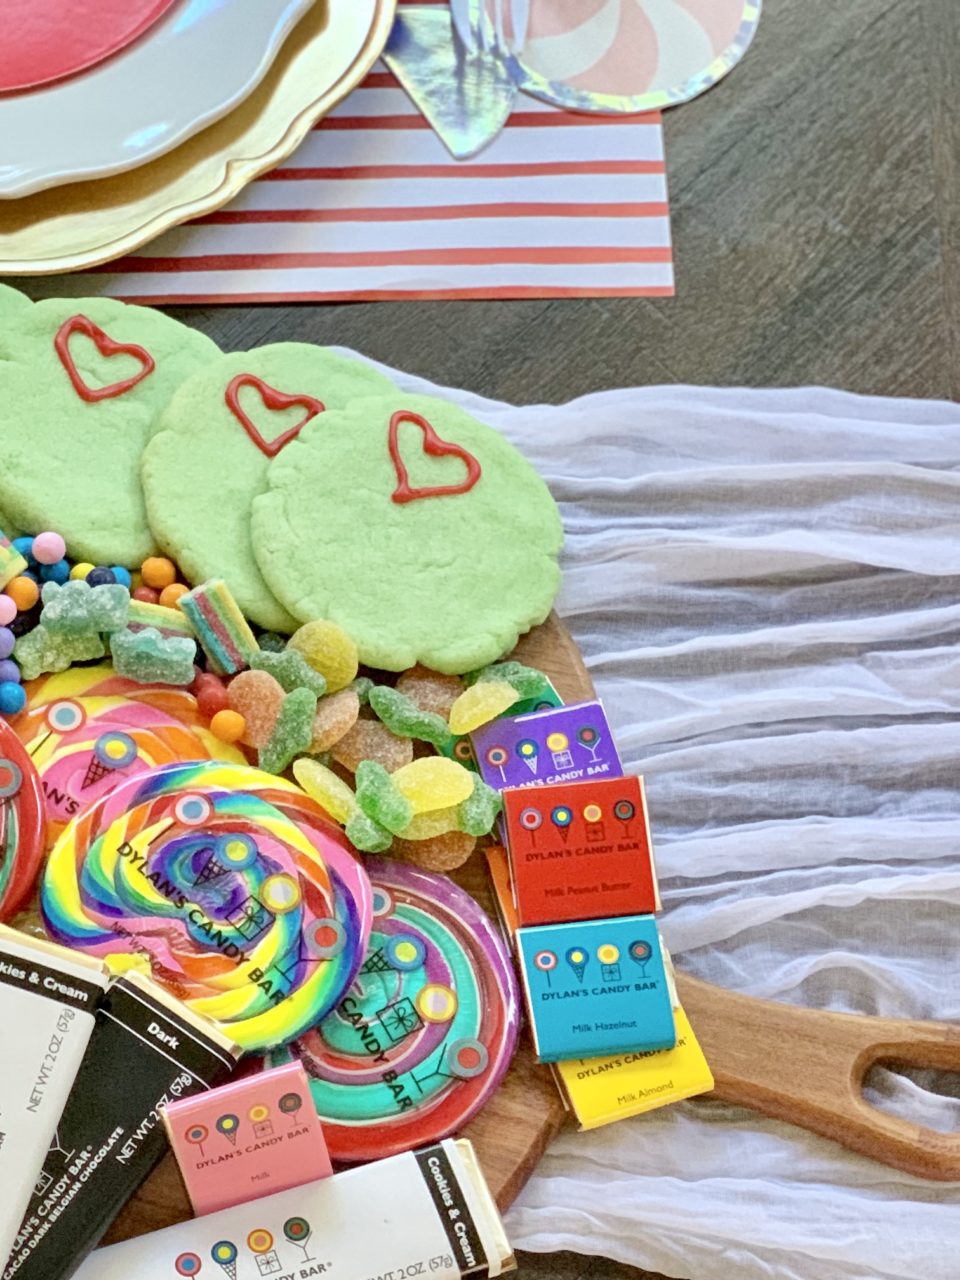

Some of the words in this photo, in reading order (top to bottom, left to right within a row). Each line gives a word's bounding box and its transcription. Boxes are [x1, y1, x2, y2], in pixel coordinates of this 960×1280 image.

[546, 769, 584, 784] CANDY
[587, 764, 609, 775] BAR
[525, 848, 572, 862] DYLAN'S
[575, 845, 613, 857] CANDY
[617, 842, 640, 852] BAR
[117, 842, 190, 909] DYLAN'S
[189, 909, 250, 966] CANDY
[248, 967, 286, 1006] BAR
[28, 971, 40, 985] &
[43, 977, 89, 1002] Cream
[541, 989, 589, 1001] DYLAN'S
[591, 985, 631, 996] CANDY
[634, 982, 657, 992] BAR
[146, 1022, 180, 1050] Dark
[572, 1023, 592, 1034] Milk
[595, 1020, 637, 1031] Hazelnut
[26, 1086, 44, 1113] NET
[56, 1008, 76, 1033] (57g)
[341, 997, 389, 1063] CANDY
[383, 1070, 413, 1112] BAR
[576, 1058, 622, 1080] DYLAN'S
[617, 1095, 637, 1106] Milk
[639, 1080, 674, 1099] Almond
[115, 1138, 138, 1165] NET
[132, 1118, 155, 1141] WT.
[169, 1072, 193, 1097] (57g)
[195, 1150, 242, 1170] DYLAN'S
[245, 1136, 284, 1153] CANDY
[287, 1126, 310, 1139] BAR
[250, 1171, 271, 1183] Milk
[3, 1247, 30, 1280] CACAO
[28, 1222, 52, 1249] DARK
[48, 1181, 82, 1223] BELGIAN
[79, 1126, 125, 1182] CHOCOLATE
[11, 1216, 40, 1255] LAN'S
[37, 1174, 71, 1217] CANDY
[68, 1150, 92, 1176] BAR
[428, 1157, 454, 1207] Cookies
[448, 1208, 460, 1220] &
[454, 1222, 477, 1267] Cream
[300, 1263, 327, 1280] BAR
[429, 1254, 453, 1273] (57g)
